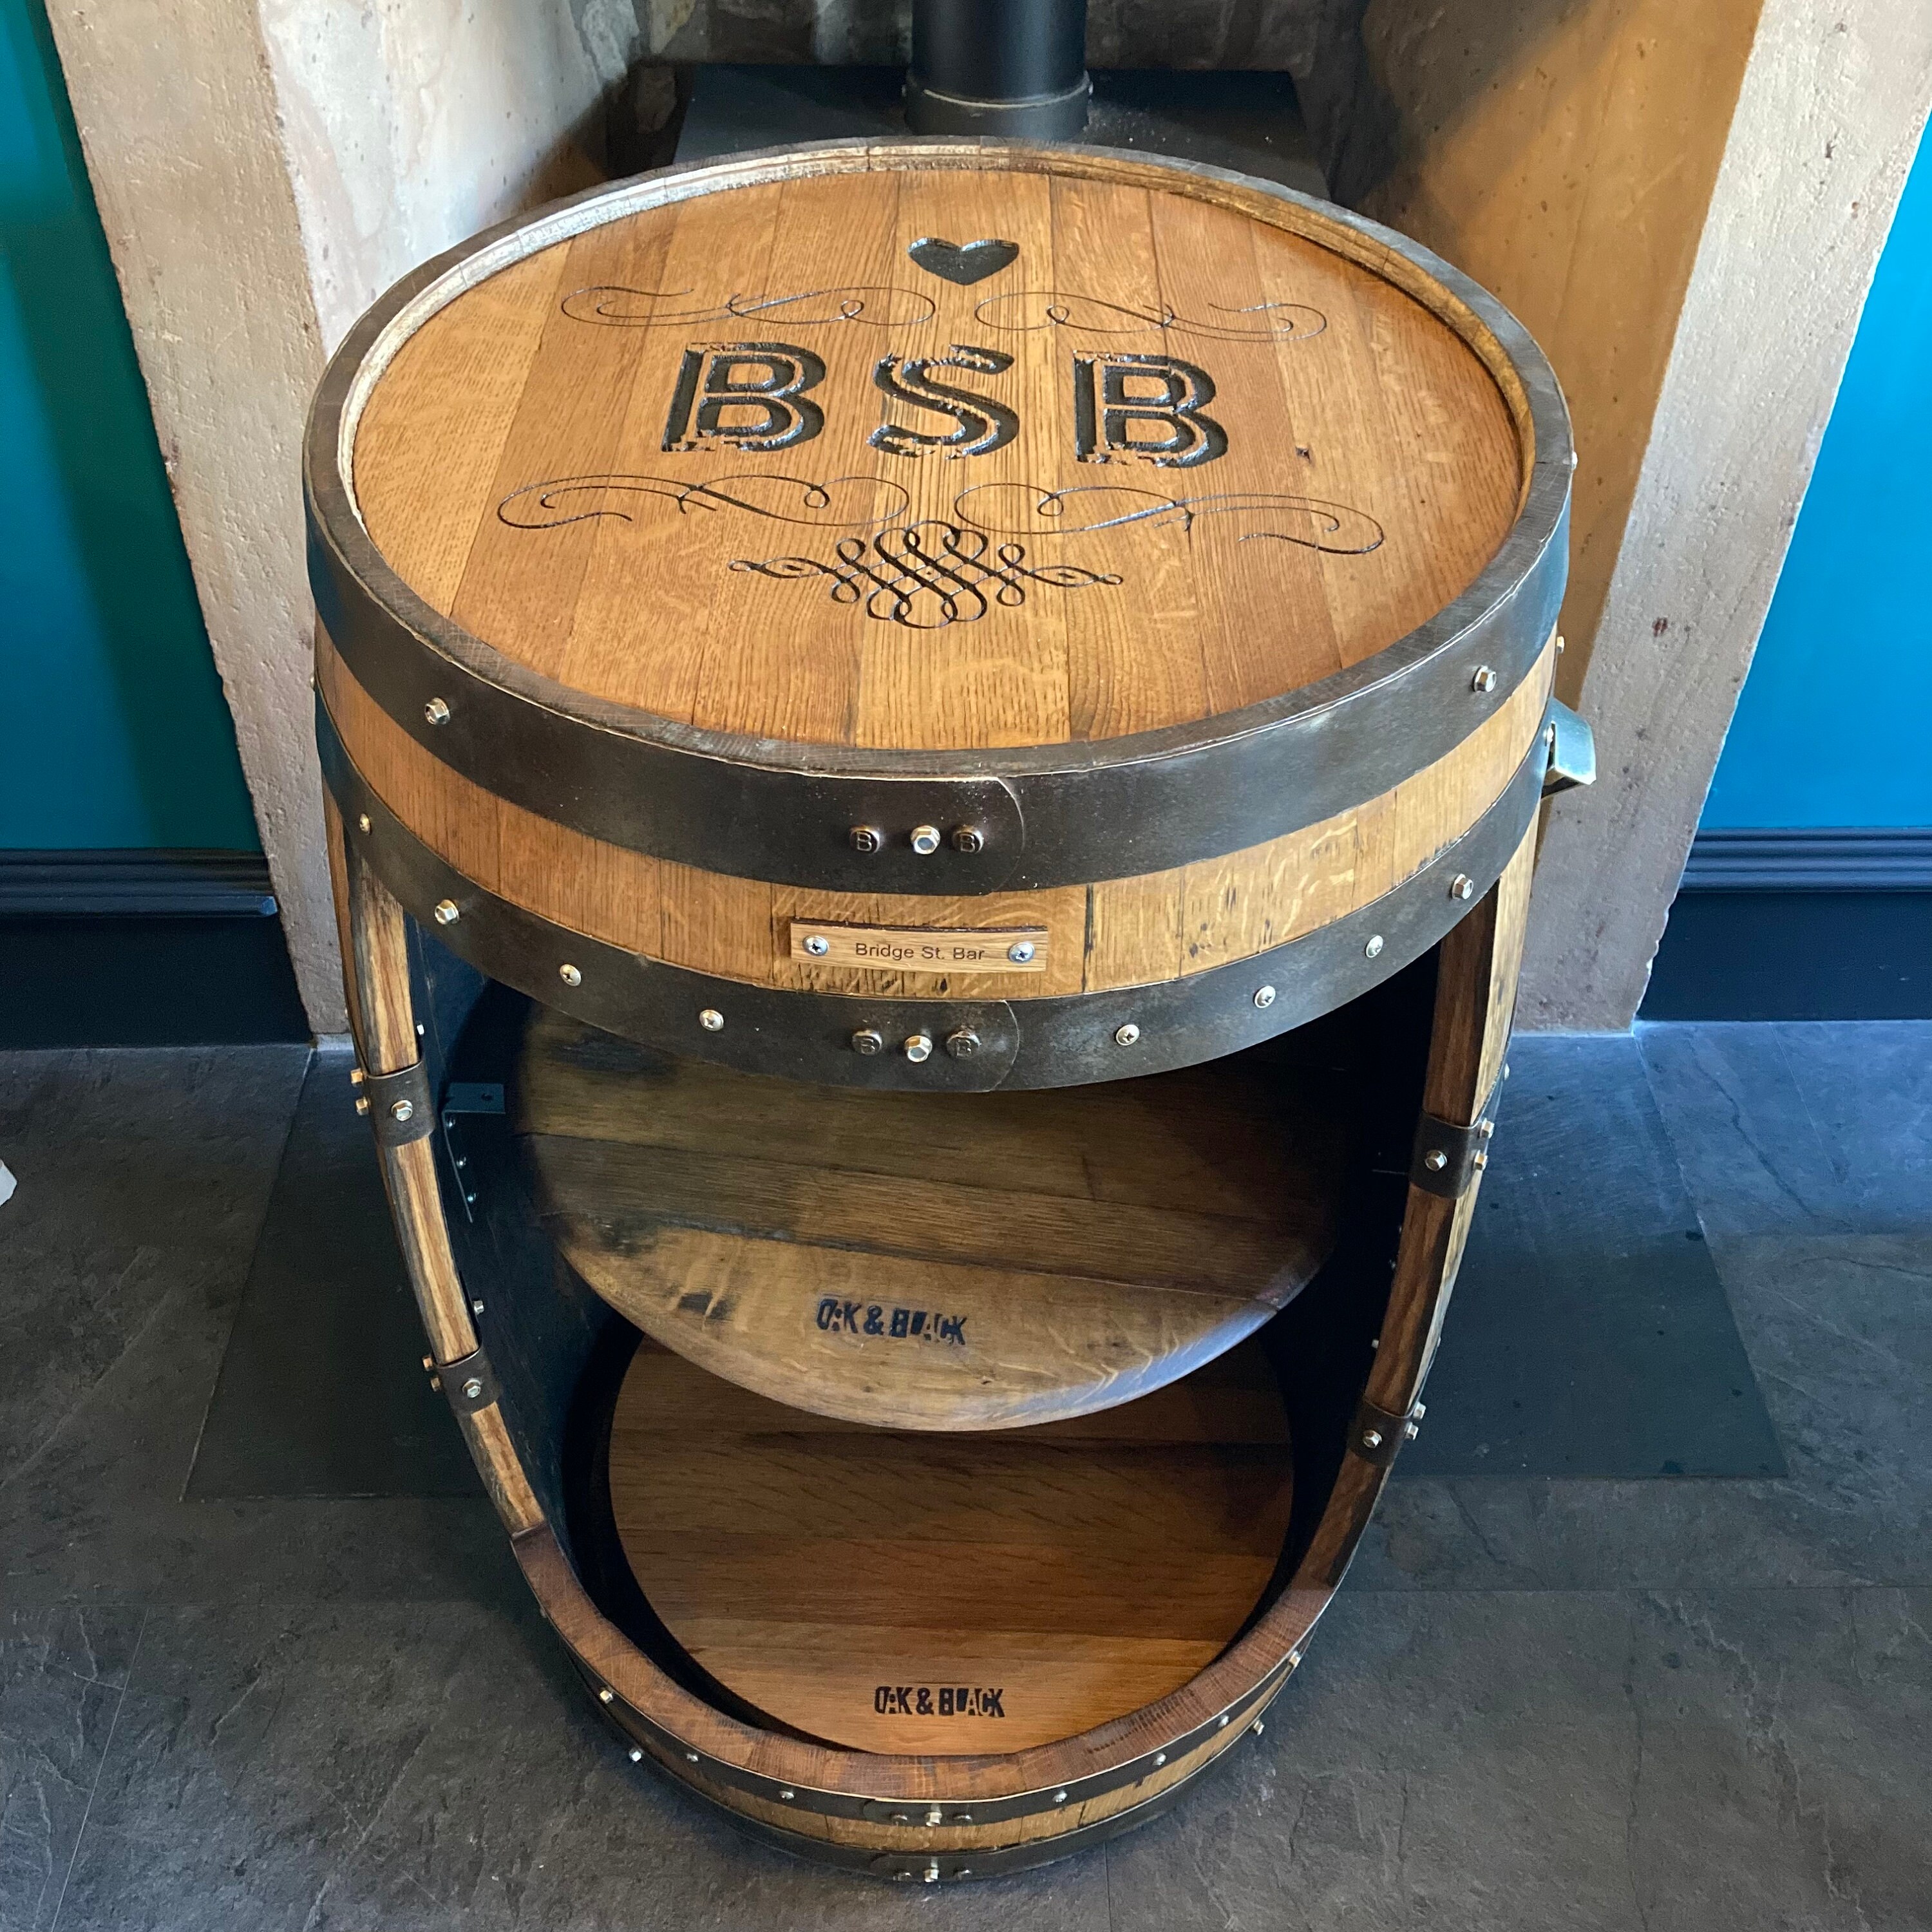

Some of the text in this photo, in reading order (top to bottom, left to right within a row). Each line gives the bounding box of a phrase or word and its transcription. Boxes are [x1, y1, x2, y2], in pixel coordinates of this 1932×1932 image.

[857, 831, 873, 851] B
[960, 833, 976, 853] B
[855, 942, 985, 961] Bridge St. Bar
[864, 1305, 884, 1335] &
[916, 1687, 934, 1715] &
